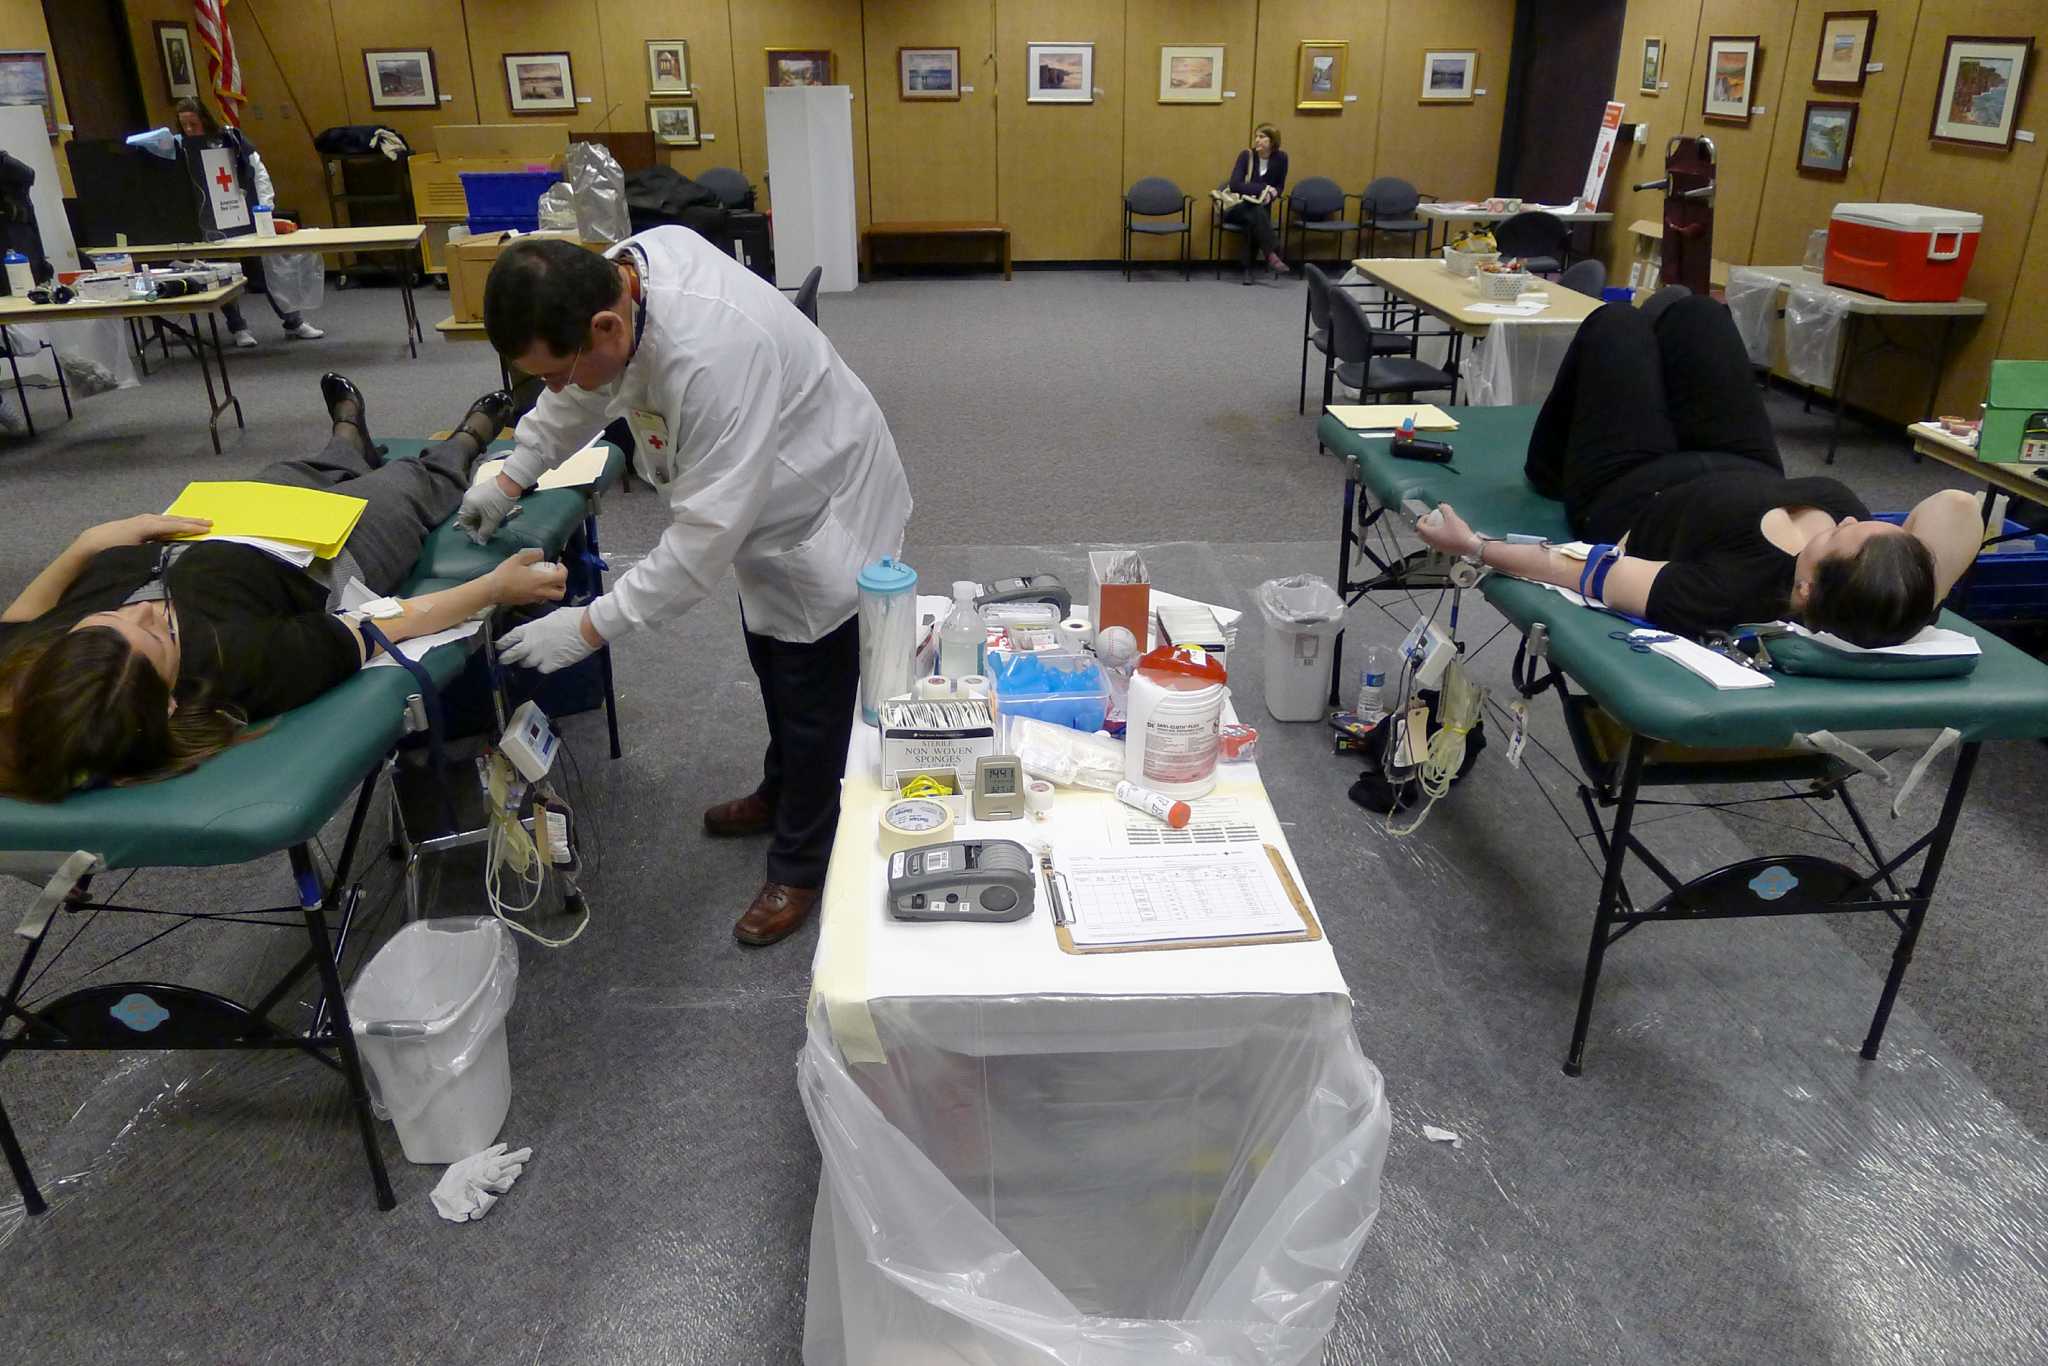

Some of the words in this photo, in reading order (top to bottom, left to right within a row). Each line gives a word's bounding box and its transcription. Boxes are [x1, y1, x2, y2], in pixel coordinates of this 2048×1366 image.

[905, 747, 928, 755] NON
[933, 746, 973, 755] WOVEN
[914, 755, 962, 763] SPONGES
